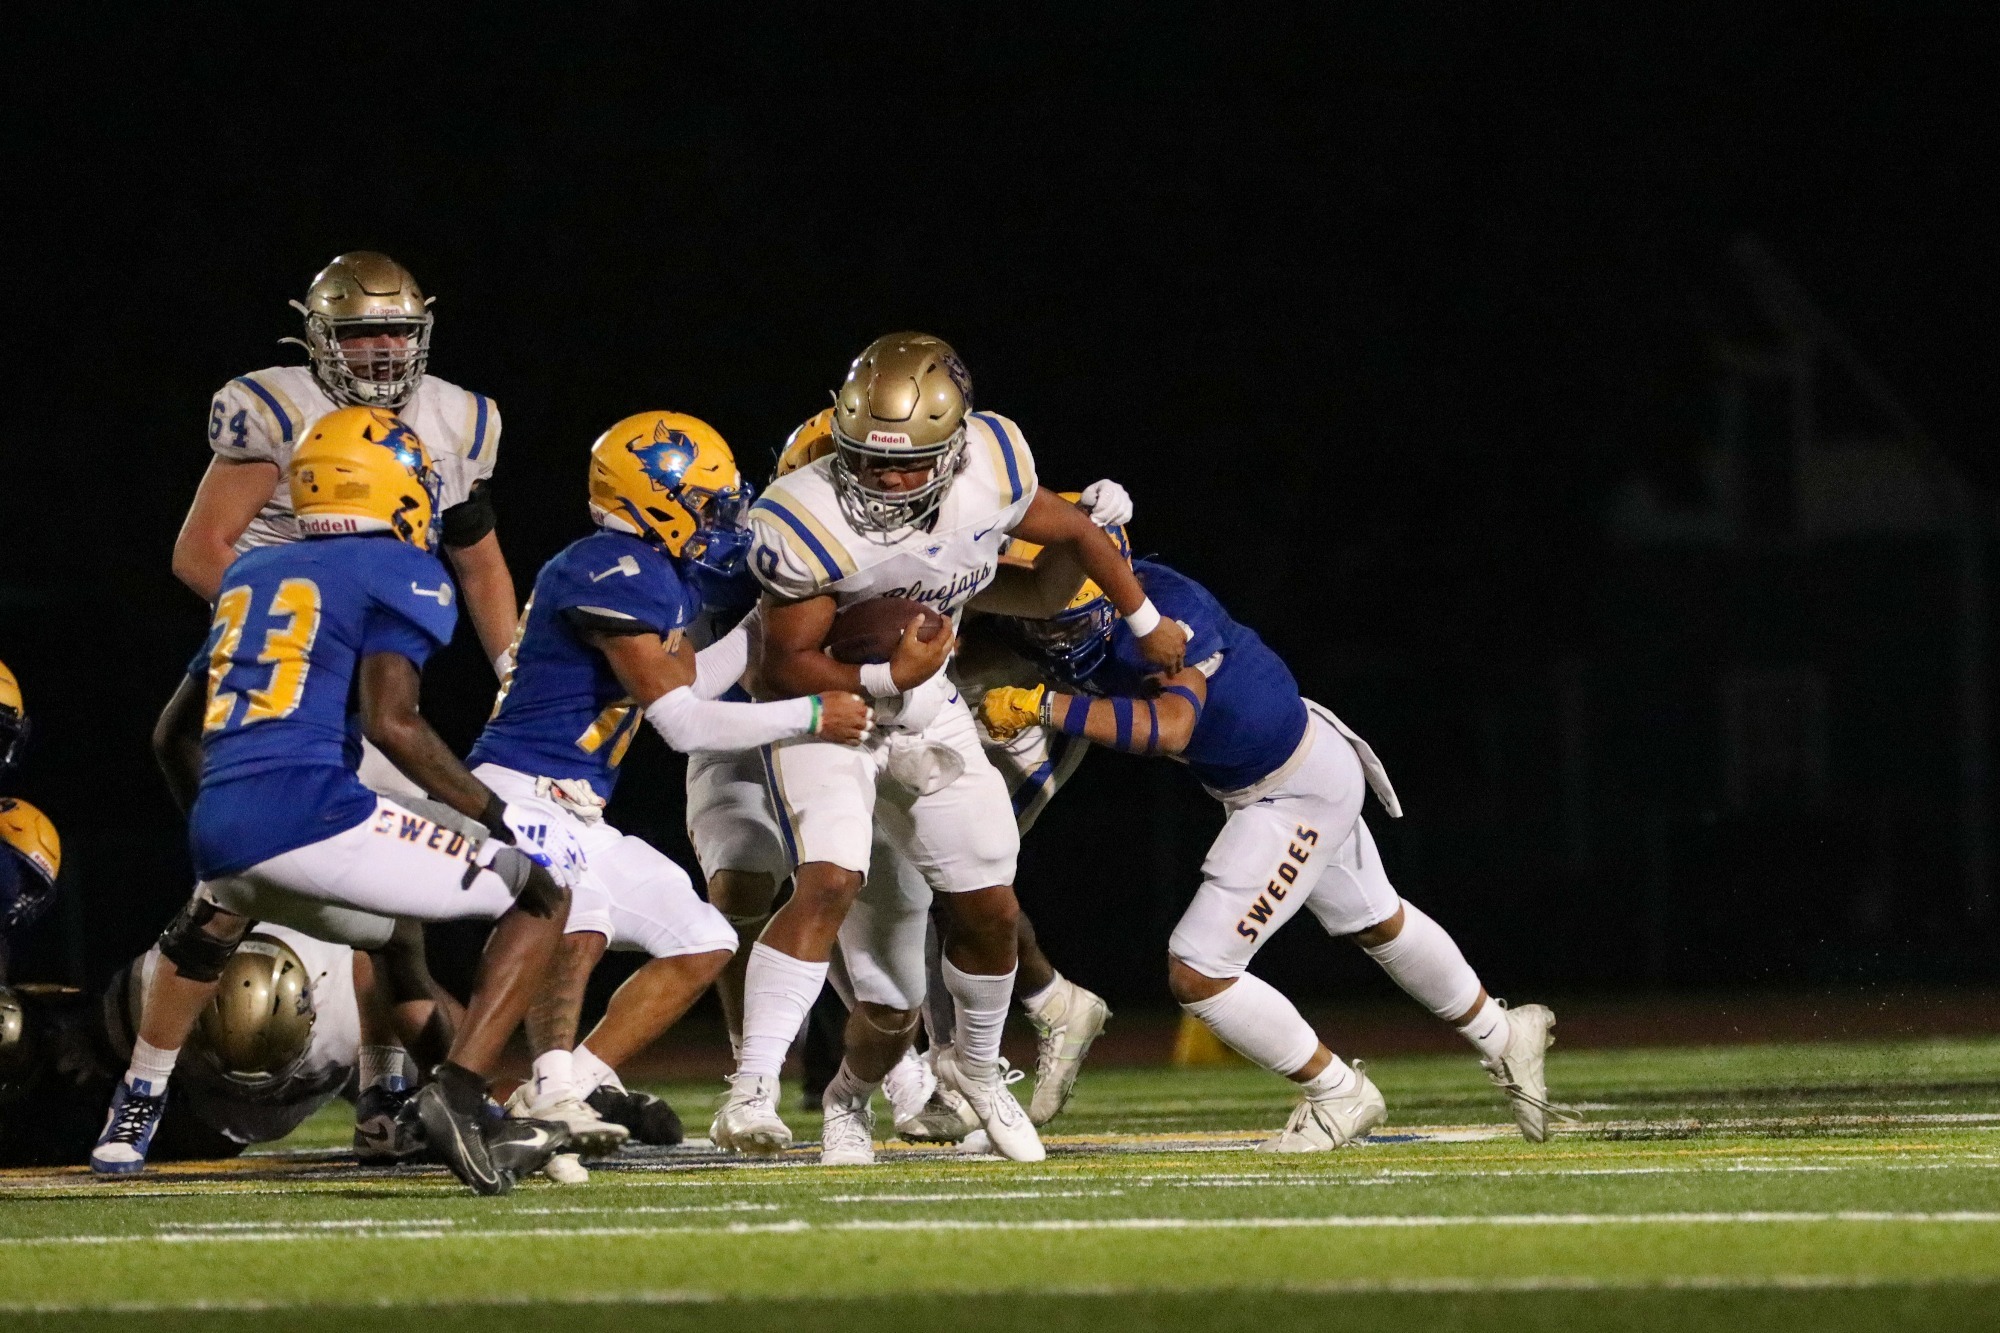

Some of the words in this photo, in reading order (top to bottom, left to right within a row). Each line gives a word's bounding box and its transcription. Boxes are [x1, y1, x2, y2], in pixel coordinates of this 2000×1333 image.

[210, 401, 248, 448] 64
[871, 433, 905, 444] Riddell
[299, 518, 357, 533] Riddell
[204, 578, 322, 731] 23
[375, 809, 487, 867] SWEDE
[1236, 823, 1319, 944] SWEDES
